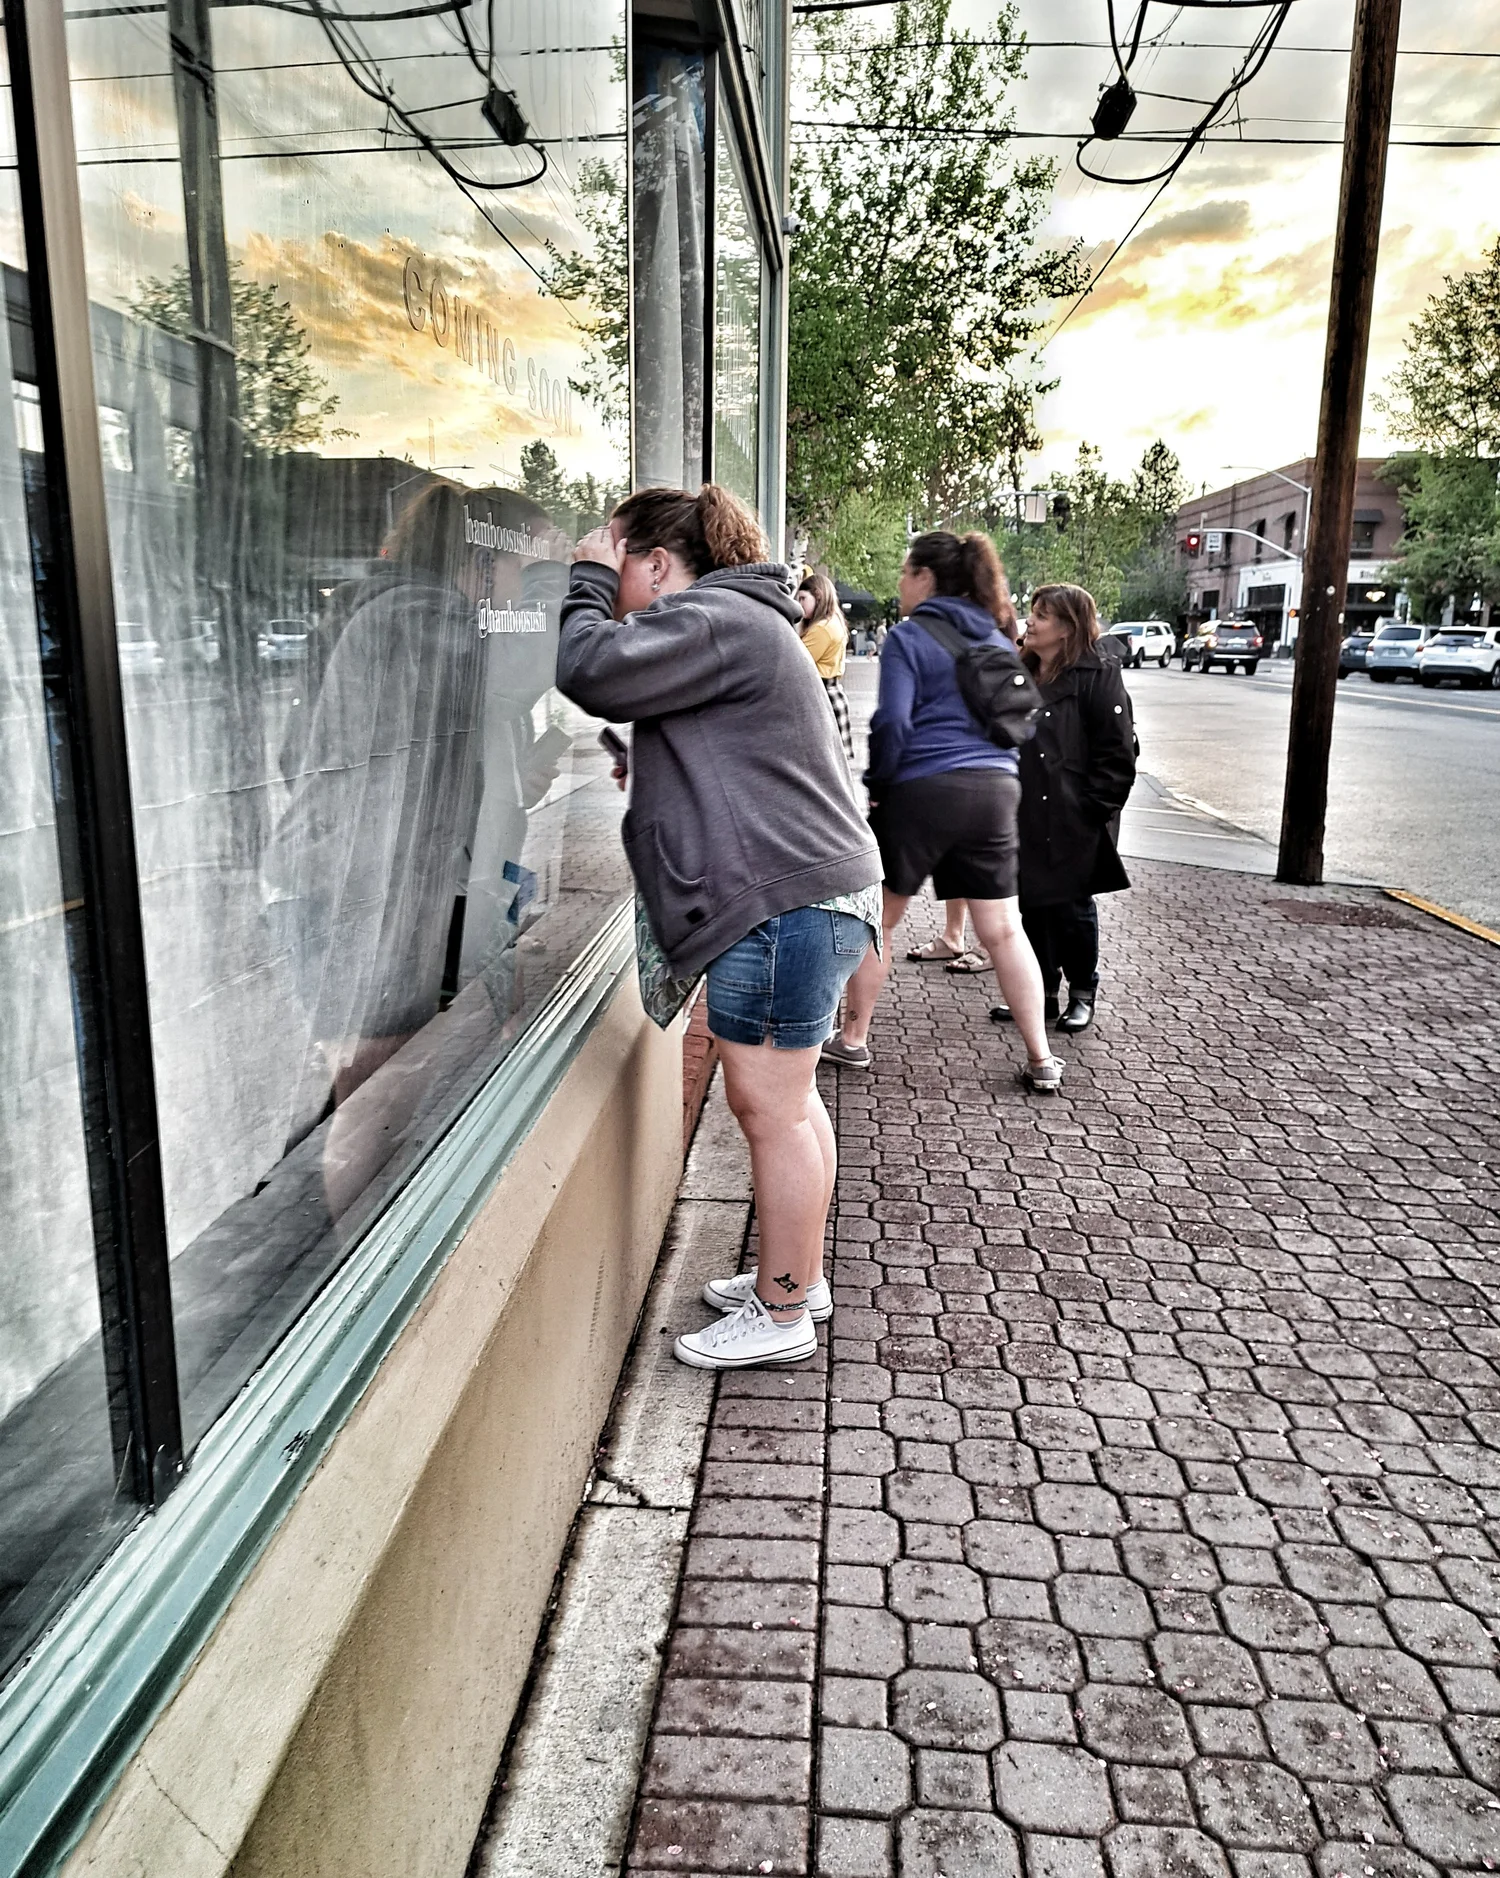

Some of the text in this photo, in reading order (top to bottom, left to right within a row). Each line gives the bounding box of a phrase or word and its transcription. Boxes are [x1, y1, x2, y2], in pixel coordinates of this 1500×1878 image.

[403, 256, 572, 436] COMING SOON
[464, 504, 550, 560] bamboosushi.com
[477, 597, 547, 639] @bamboosushi
